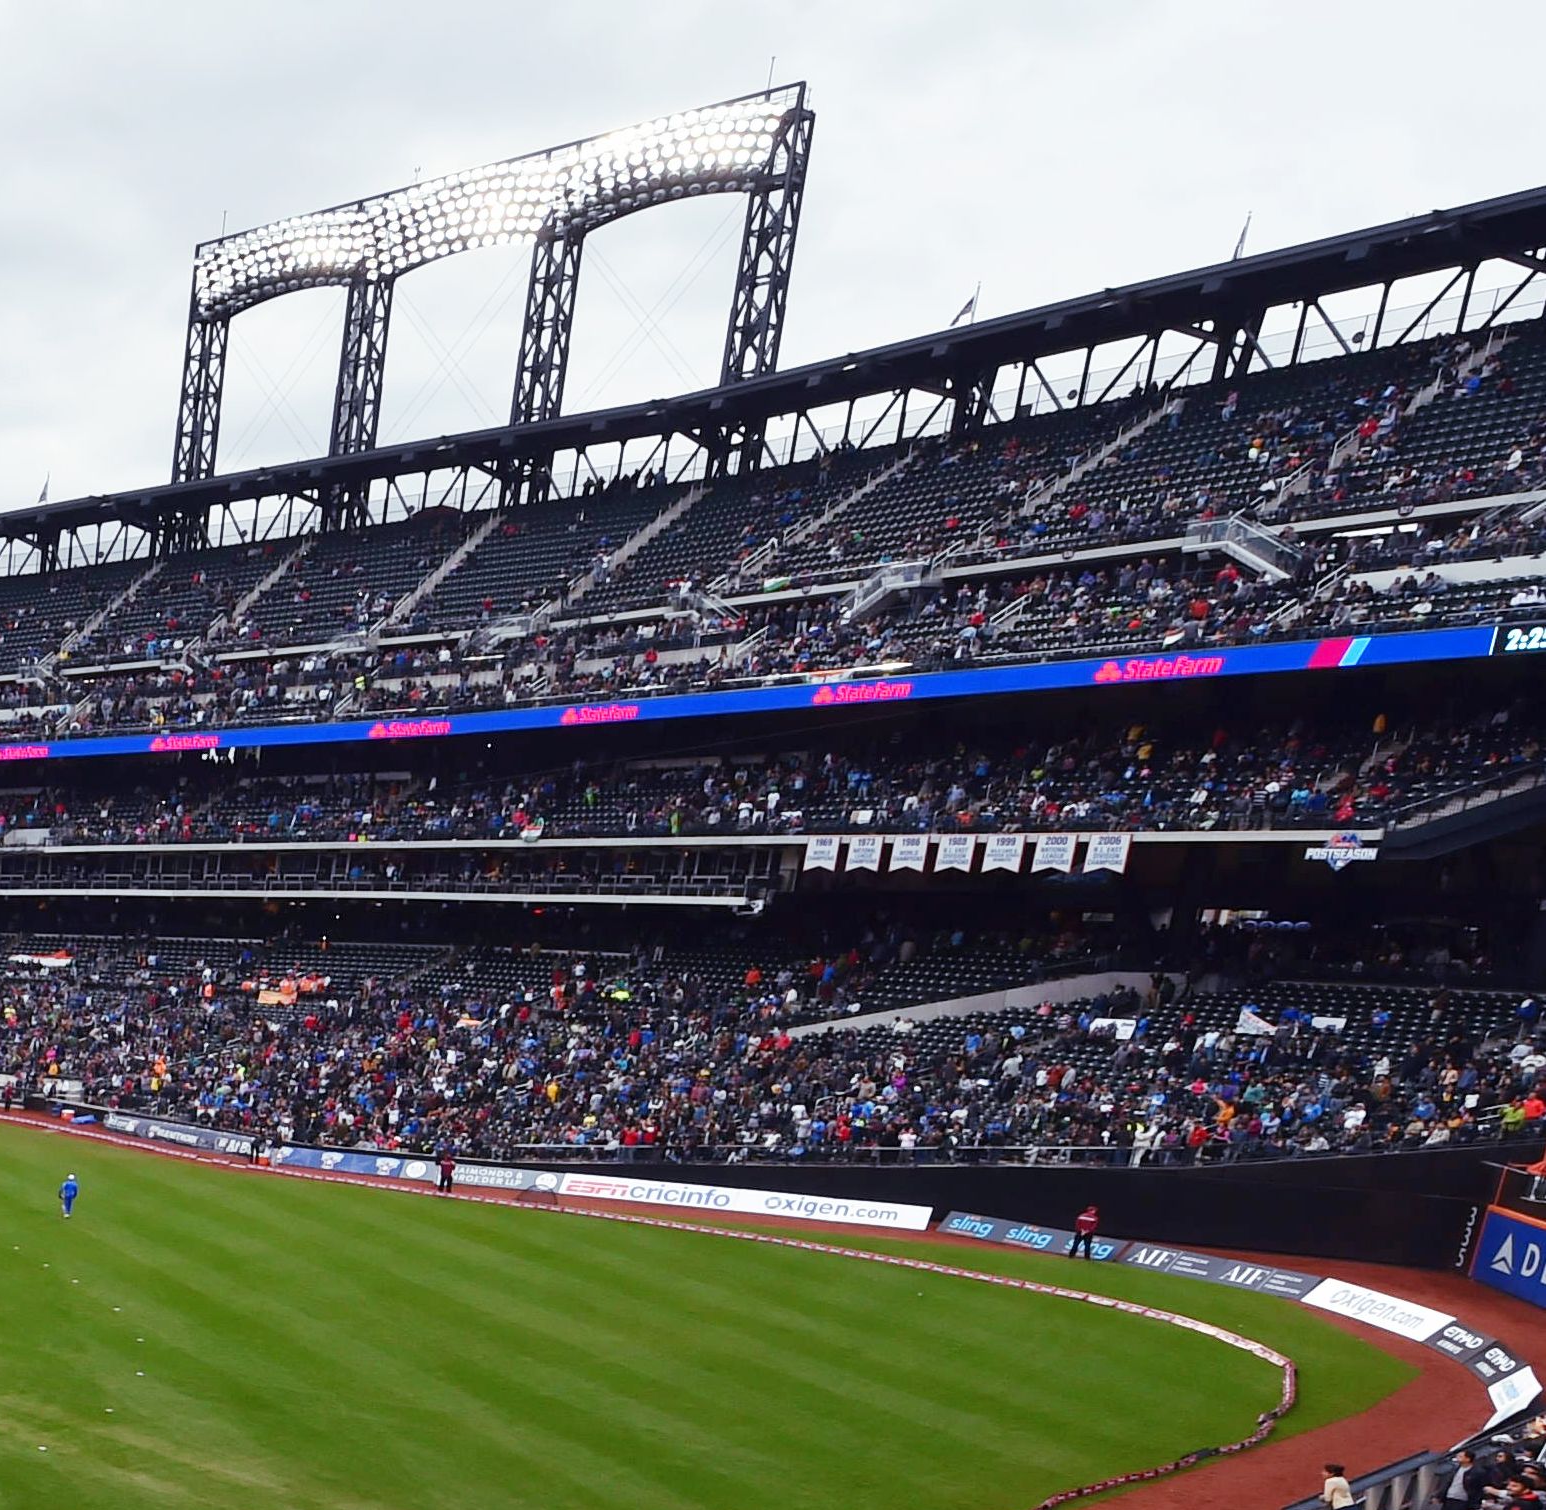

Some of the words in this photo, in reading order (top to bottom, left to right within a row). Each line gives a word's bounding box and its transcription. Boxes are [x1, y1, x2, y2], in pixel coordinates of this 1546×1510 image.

[1123, 656, 1224, 681] StateFarm
[1044, 836, 1068, 846] 2000
[1097, 836, 1121, 846] 2006
[1304, 848, 1379, 860] POSTSEASON
[565, 1179, 731, 1208] ESPNcricinfo
[948, 1215, 995, 1238] sling
[1005, 1225, 1054, 1249] sling
[1127, 1247, 1176, 1267] AIF
[1520, 1243, 1546, 1284] D
[1219, 1265, 1270, 1285] AIF
[1444, 1325, 1484, 1350] ETIHAD
[1484, 1348, 1516, 1373] ETIHAD
